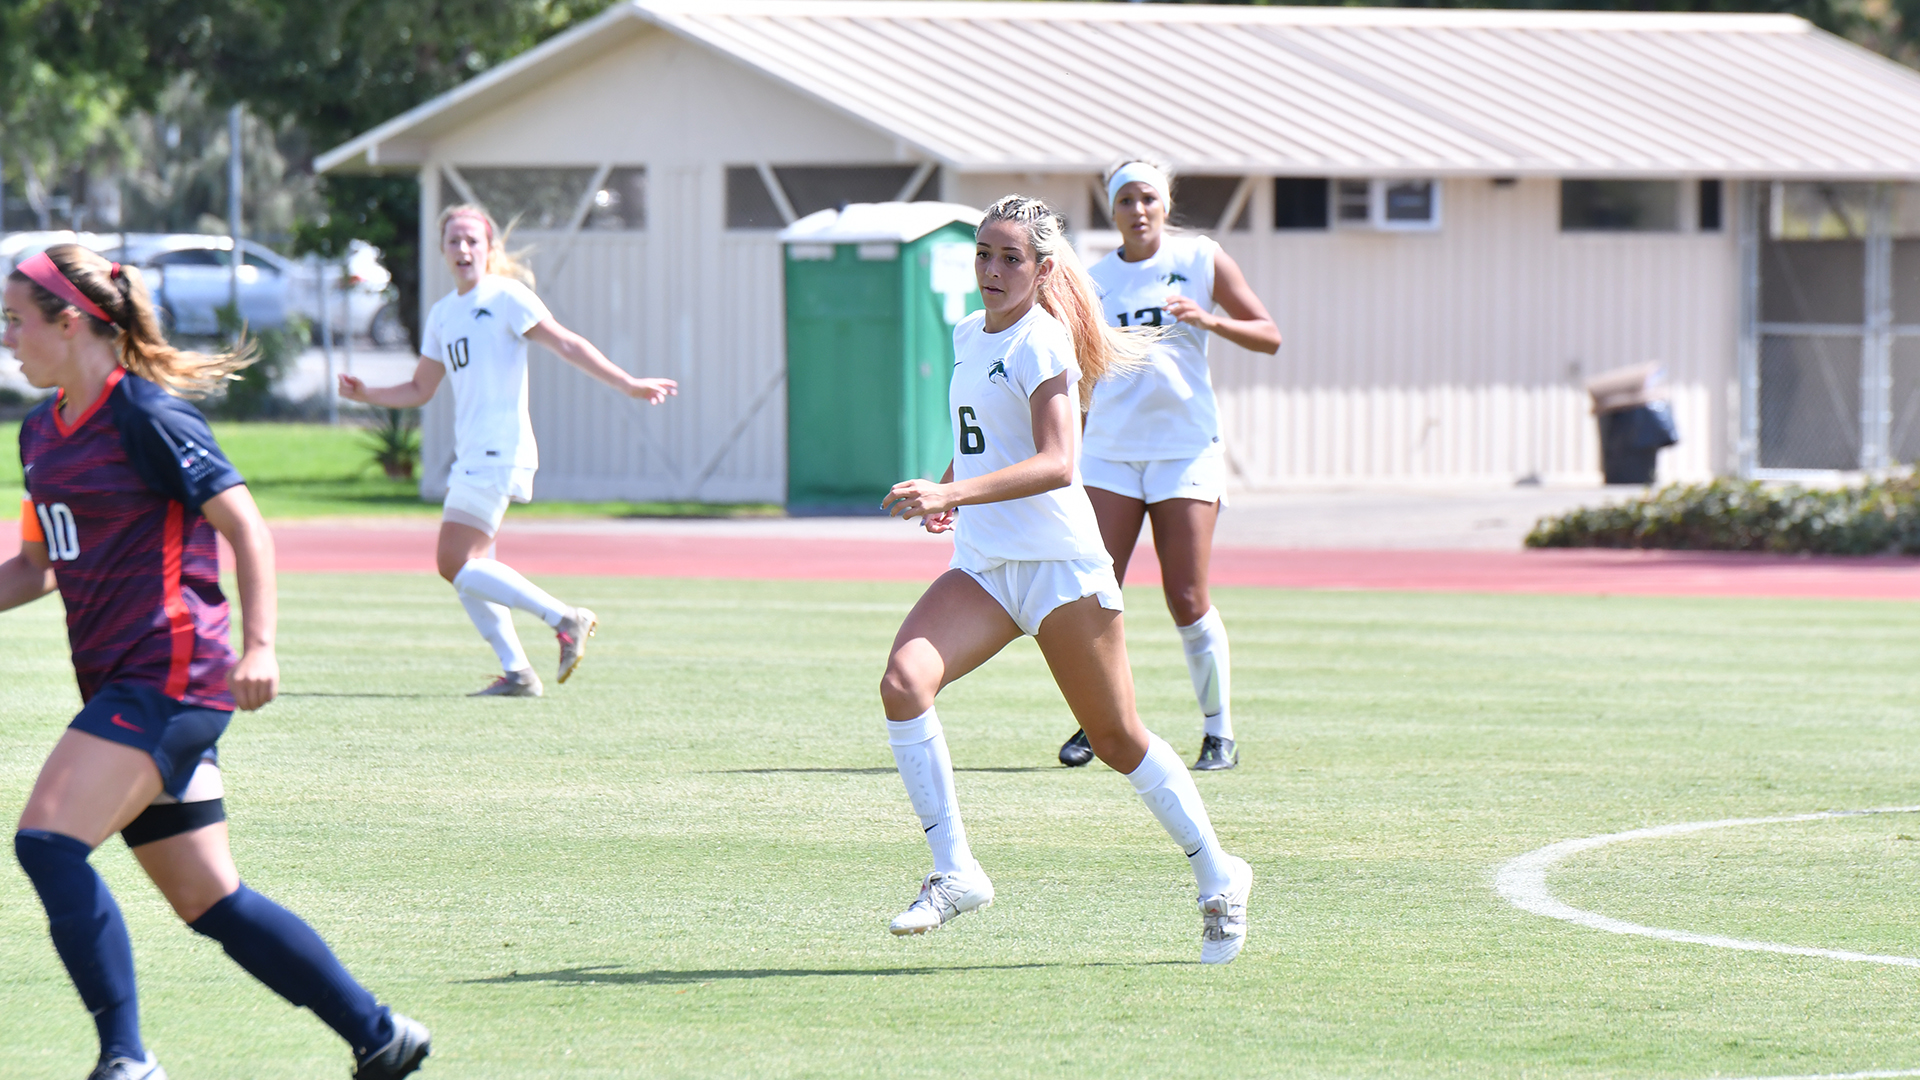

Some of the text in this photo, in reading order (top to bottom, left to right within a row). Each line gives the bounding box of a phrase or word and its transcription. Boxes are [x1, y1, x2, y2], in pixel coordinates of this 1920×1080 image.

[447, 337, 469, 372] 10
[958, 406, 986, 455] 6
[37, 502, 80, 561] 10
